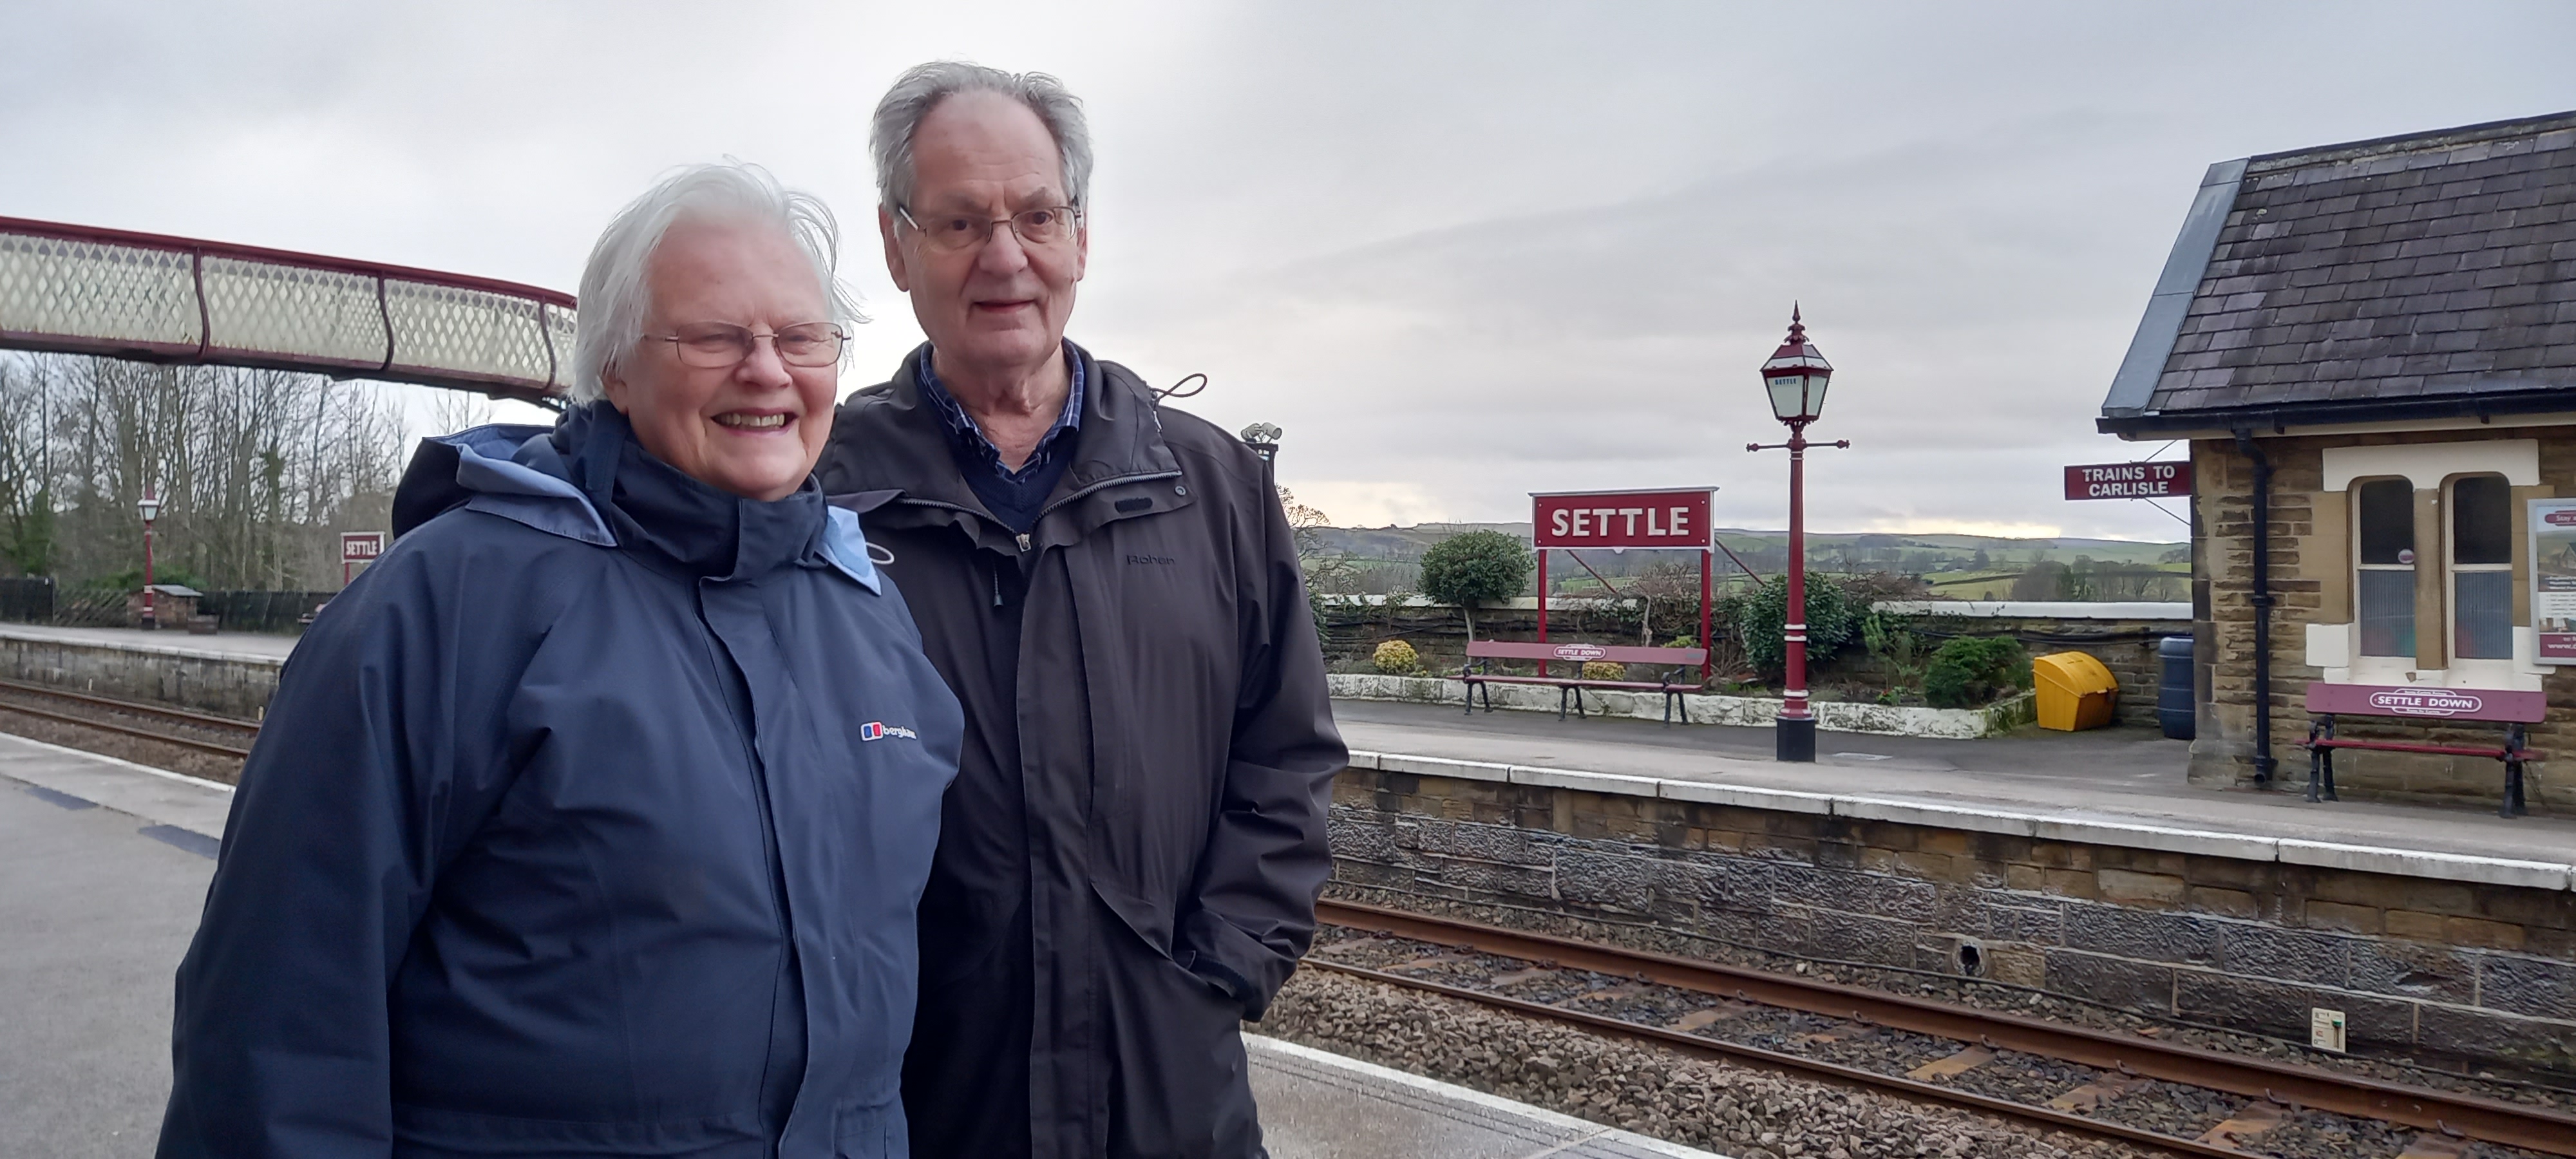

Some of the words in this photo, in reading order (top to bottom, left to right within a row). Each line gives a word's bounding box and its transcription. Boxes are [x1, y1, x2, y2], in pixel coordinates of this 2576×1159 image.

[2082, 466, 2145, 482] TRAINS
[2153, 465, 2175, 480] TO
[2088, 481, 2169, 496] CARLISLE
[1551, 507, 1689, 537] SETTLE
[346, 540, 377, 556] SETTLE
[1126, 554, 1175, 565] Rohan
[2377, 696, 2422, 706] SETTLE
[2428, 699, 2472, 708] DOWN
[882, 724, 917, 740] bergha
